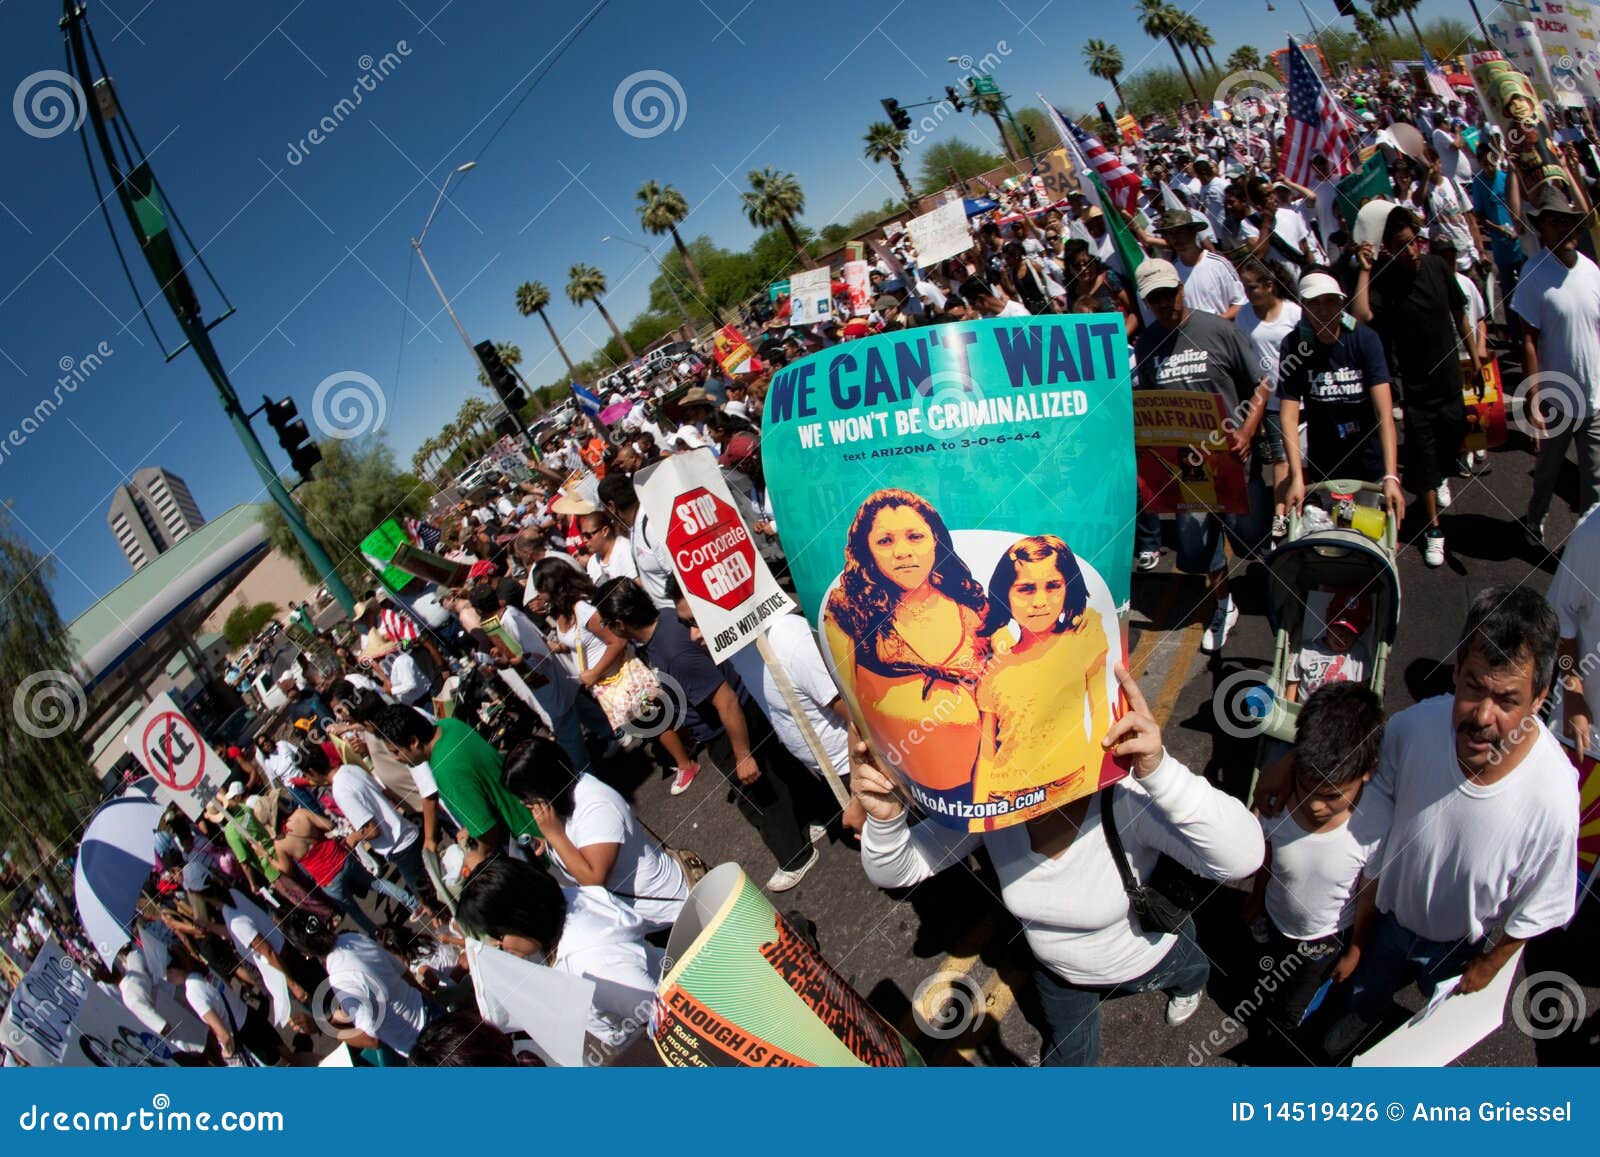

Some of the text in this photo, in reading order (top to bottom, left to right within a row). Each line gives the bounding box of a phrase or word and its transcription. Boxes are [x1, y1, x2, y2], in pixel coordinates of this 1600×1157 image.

[770, 323, 1119, 424] WE CAN'T WAIT
[1154, 349, 1208, 368] Legalize
[1156, 362, 1207, 380] Arizona
[1307, 366, 1363, 385] Legalize
[1309, 382, 1363, 397] Arizona
[798, 390, 1088, 449] WE WON'T BE CRIMINALIZED
[843, 430, 1041, 463] text ARIZONA to 3-0-6-4-4
[676, 494, 719, 536] STOP
[676, 525, 746, 573] Corporate
[701, 550, 752, 601] GREED
[714, 591, 788, 653] JOBS WITH JUSTICE
[151, 722, 195, 778] ICE
[666, 1034, 690, 1057] more
[669, 991, 747, 1052] ENOUGH
[744, 1038, 769, 1063] IS
[673, 1024, 700, 1049] Raids
[661, 1041, 669, 1053] to
